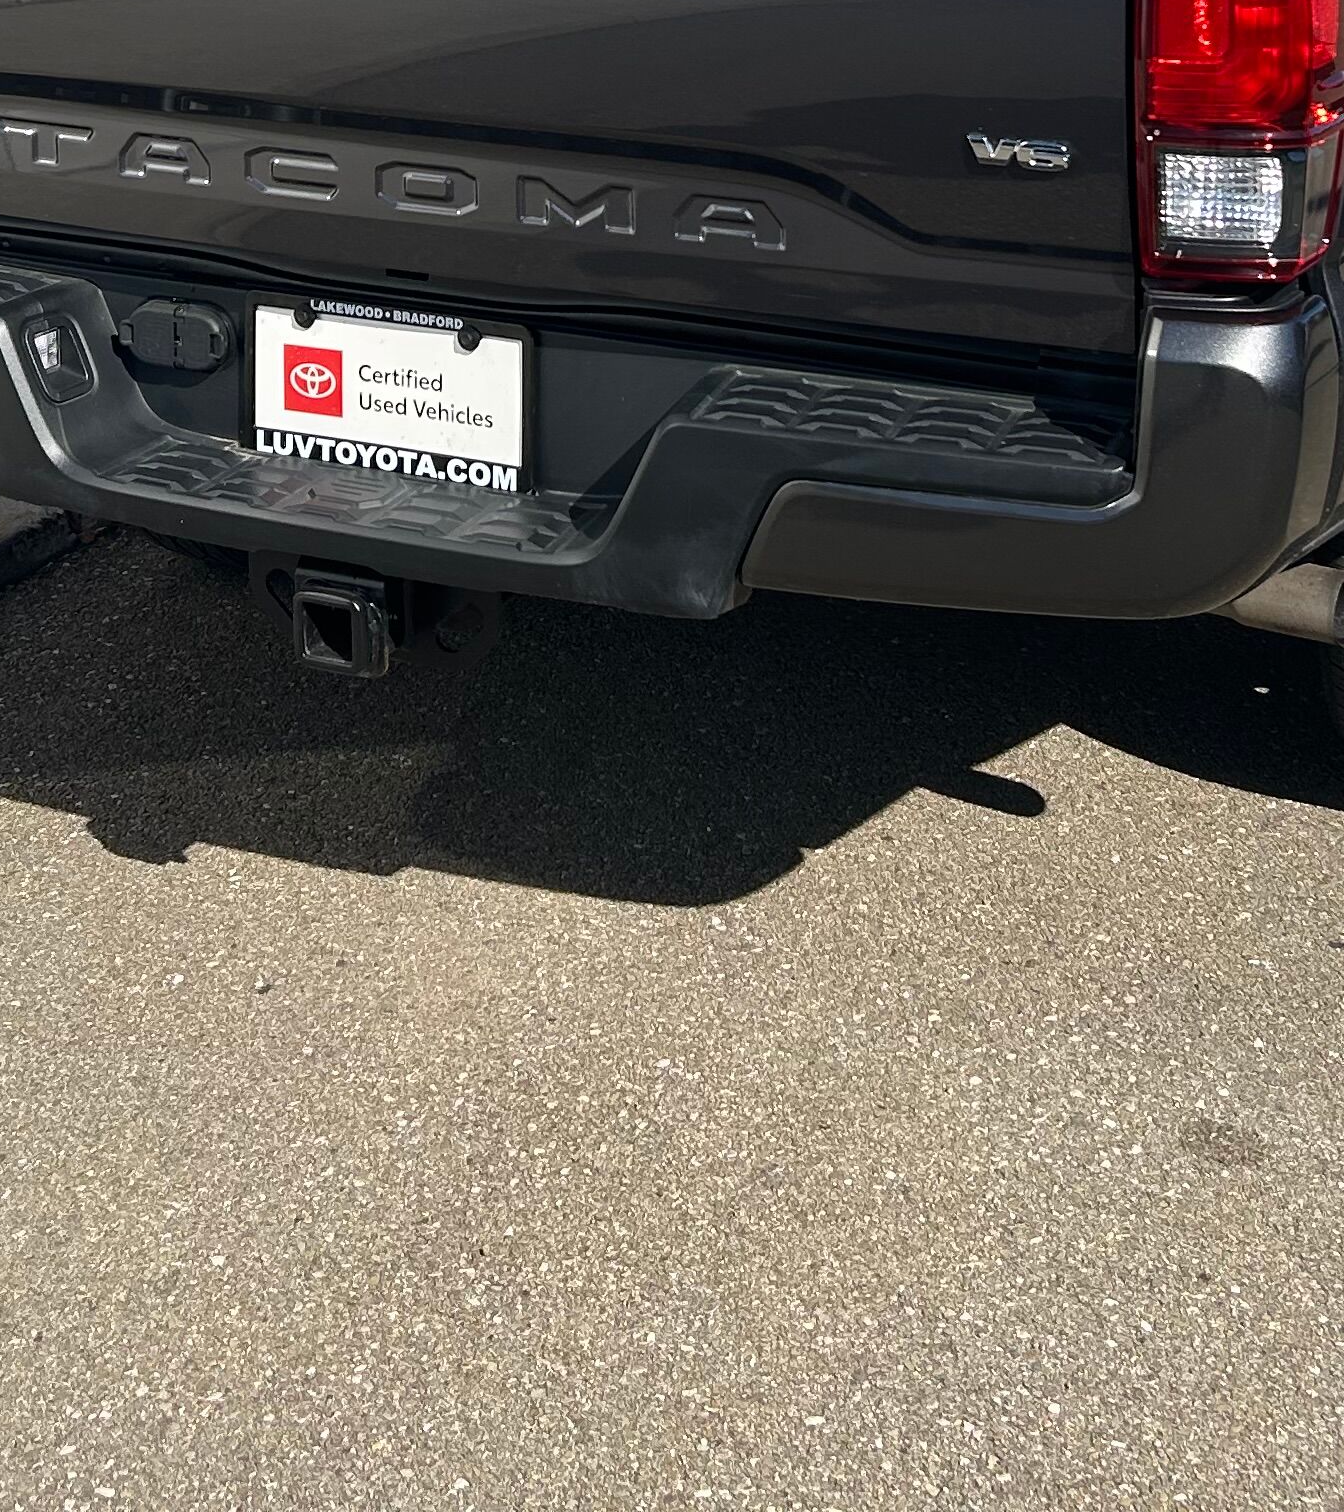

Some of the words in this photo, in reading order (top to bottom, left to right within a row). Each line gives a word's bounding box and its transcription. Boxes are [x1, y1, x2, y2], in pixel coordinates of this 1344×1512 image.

[966, 131, 1070, 172] V6
[310, 299, 383, 319] LAKEWOOD
[393, 310, 464, 330] BRADFORD
[358, 364, 443, 392] Certified
[359, 392, 407, 416] Used
[413, 399, 494, 429] Vehicles
[256, 429, 518, 492] LUVTOYOTA.COM
